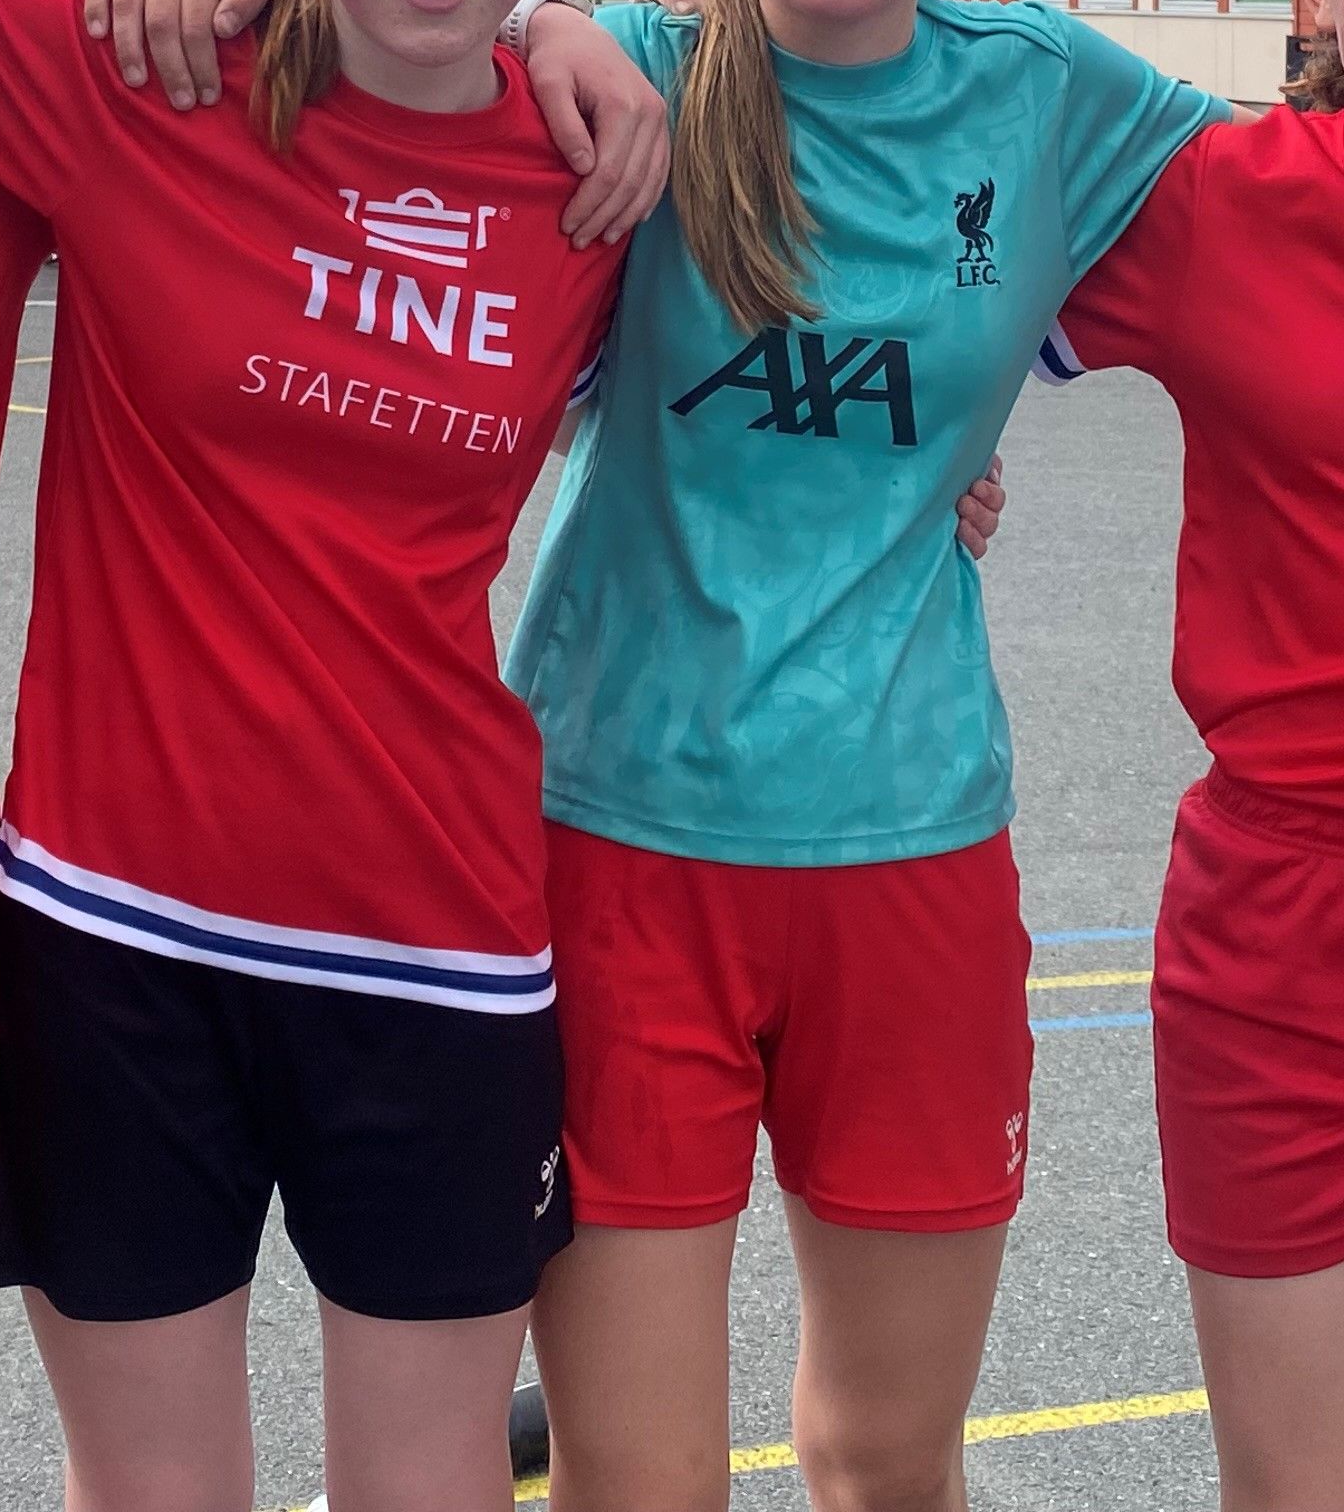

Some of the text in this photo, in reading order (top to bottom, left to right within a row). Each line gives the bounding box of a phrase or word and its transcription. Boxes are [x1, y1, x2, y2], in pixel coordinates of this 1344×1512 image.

[292, 246, 517, 368] TINE
[239, 354, 523, 455] STAFETTEN
[667, 326, 919, 447] AXA
